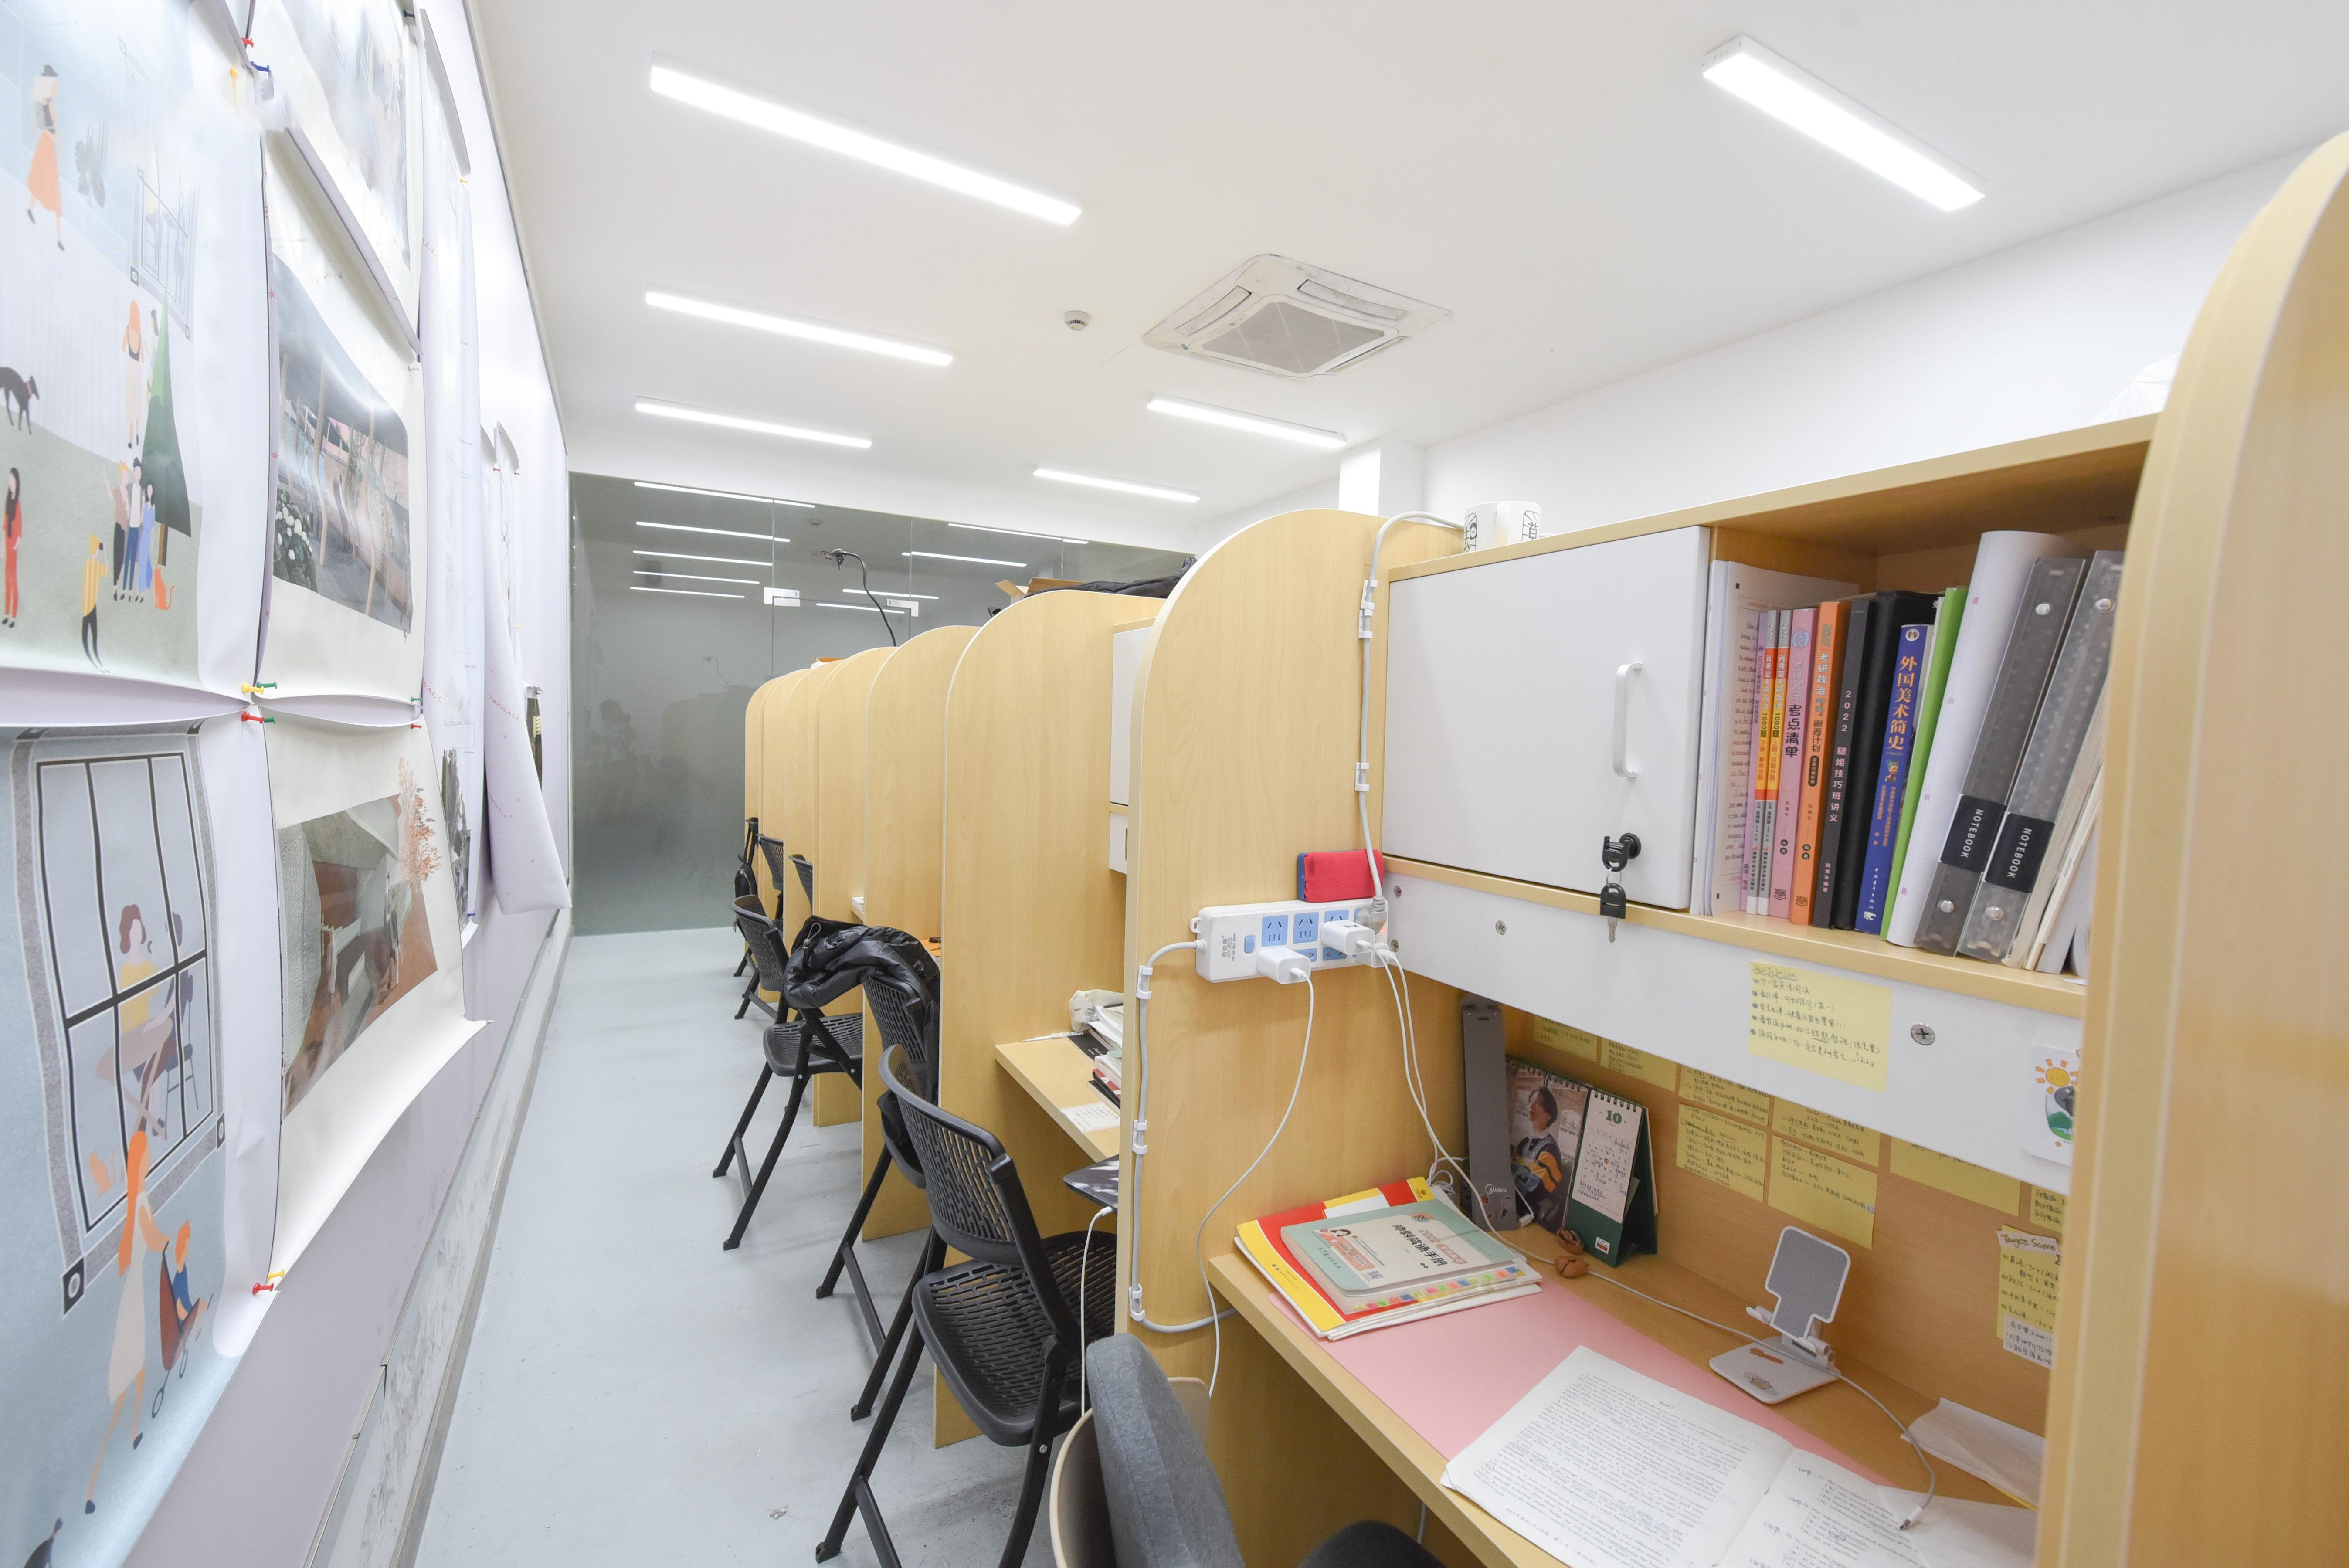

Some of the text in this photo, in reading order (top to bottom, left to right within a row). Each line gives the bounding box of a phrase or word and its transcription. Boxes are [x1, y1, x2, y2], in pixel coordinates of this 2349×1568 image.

[1774, 655, 1786, 710] 肖秀荣考研政治
[1792, 661, 1803, 701] 考研政治
[1816, 654, 1829, 695] 考研政治
[1888, 656, 1917, 750] 外国美术简史
[1785, 704, 1802, 758] 考点清单
[1829, 690, 1852, 823] 2022 腿姐技巧班讲义
[1960, 808, 1984, 858] NOTEBOOK
[2007, 828, 2033, 879] NOTEBOOK
[1606, 1110, 1622, 1124] 10
[1487, 1184, 1508, 1194] Midea
[1391, 1224, 1449, 1267] 冲刺背诵手册
[2031, 1238, 2056, 1251] Score
